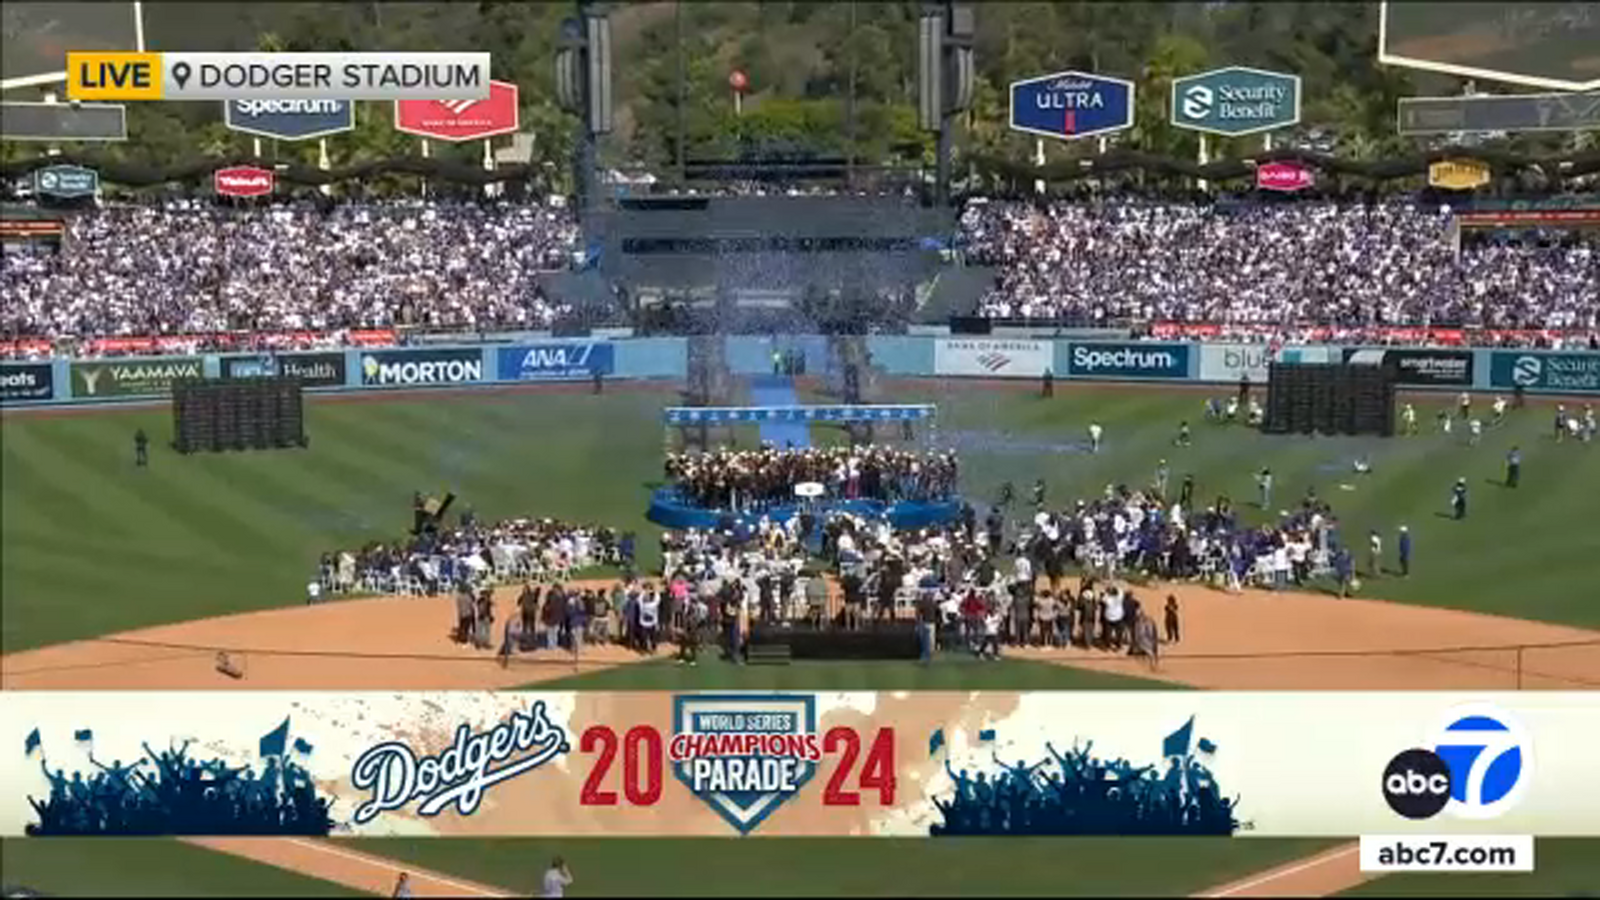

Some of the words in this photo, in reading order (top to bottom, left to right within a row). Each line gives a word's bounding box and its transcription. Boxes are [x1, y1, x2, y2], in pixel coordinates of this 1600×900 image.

[1036, 92, 1104, 109] ULTRA
[1219, 85, 1286, 102] Security
[1219, 102, 1276, 118] Benefit
[521, 348, 566, 368] ANA
[1073, 346, 1173, 371] Spectrum
[283, 361, 337, 379] Health
[380, 359, 481, 384] MORTON
